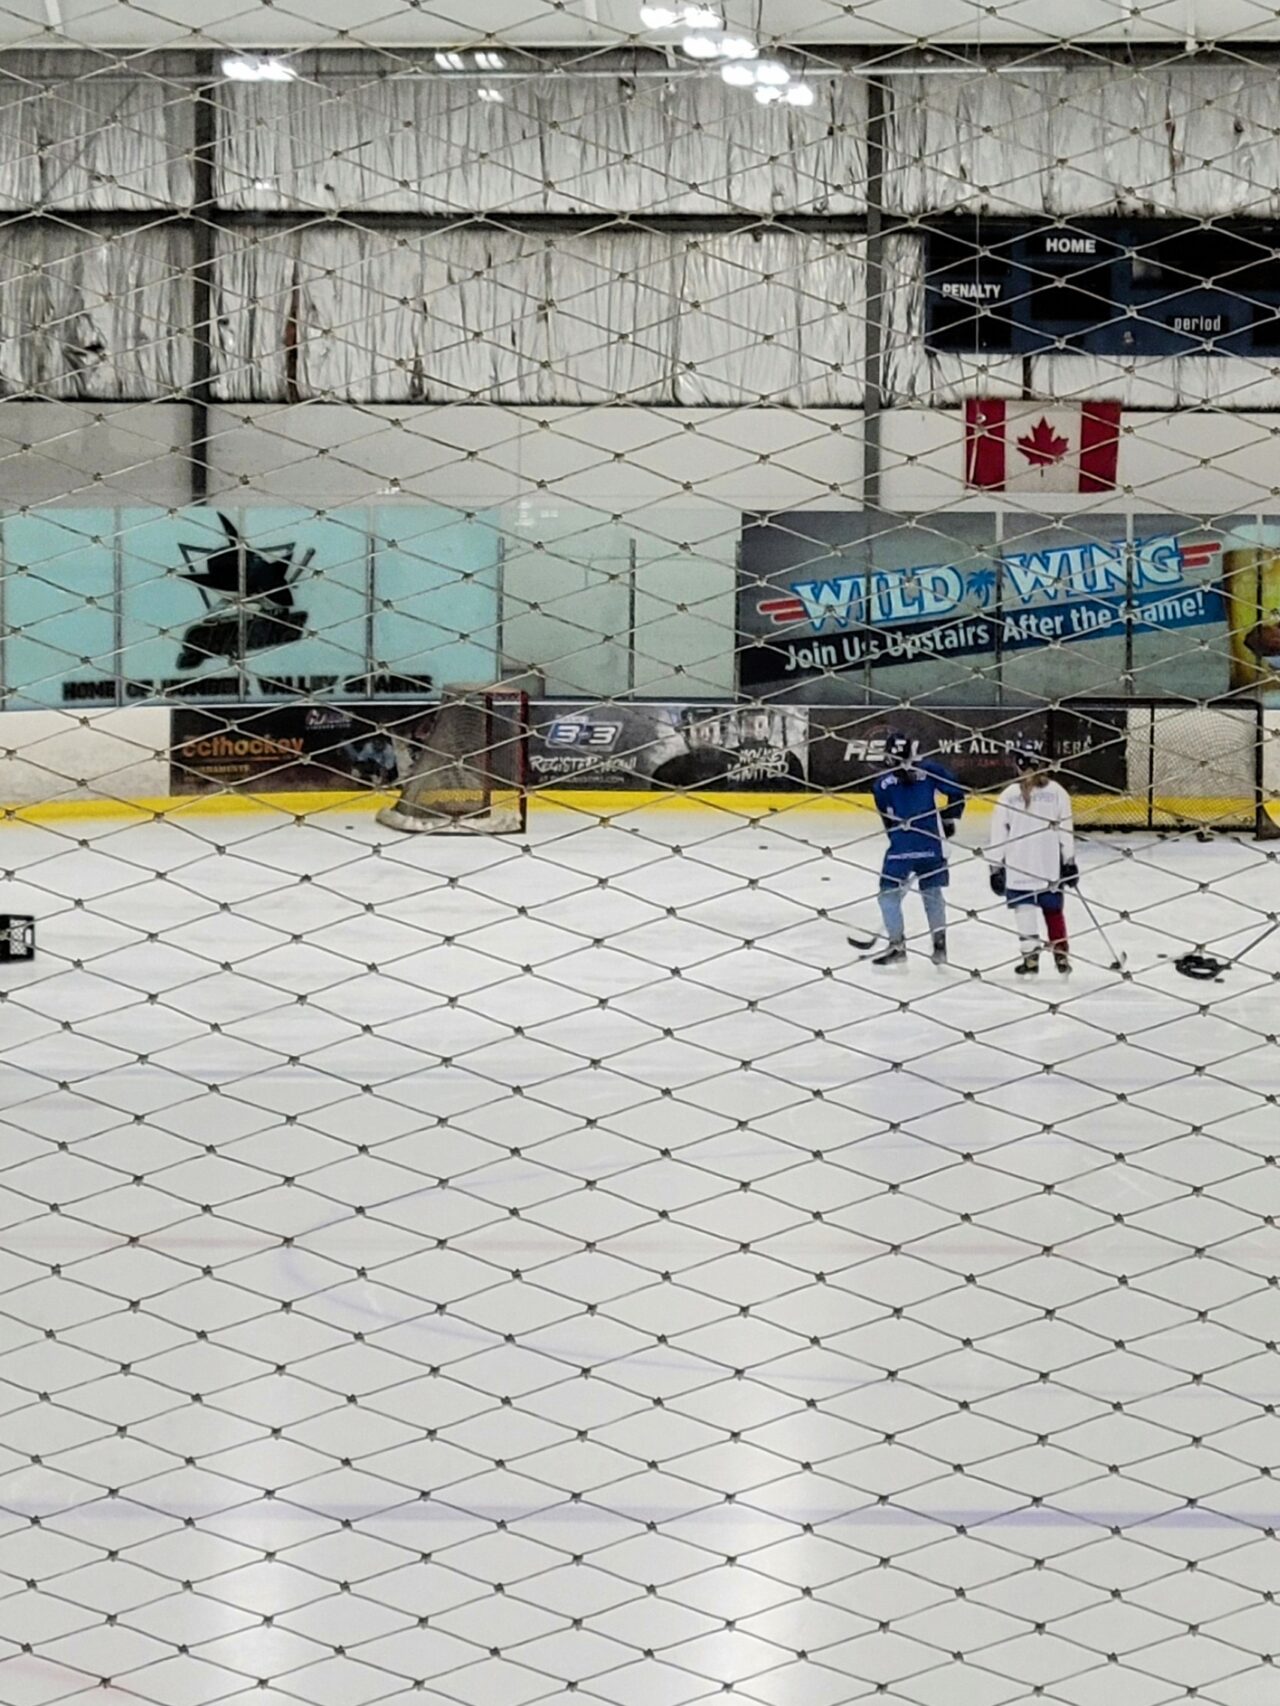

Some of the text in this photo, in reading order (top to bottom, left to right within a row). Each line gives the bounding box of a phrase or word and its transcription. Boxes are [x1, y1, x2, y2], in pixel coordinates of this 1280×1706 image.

[1046, 238, 1096, 253] HOME
[942, 283, 1000, 298] PENALTY
[1174, 315, 1221, 332] period
[790, 535, 1183, 631] WILD WING
[785, 640, 837, 671] Join
[885, 622, 990, 659] Upstairs
[1003, 611, 1064, 642] After
[1070, 605, 1112, 632] the
[939, 739, 962, 754] WE
[969, 740, 998, 754] ALL
